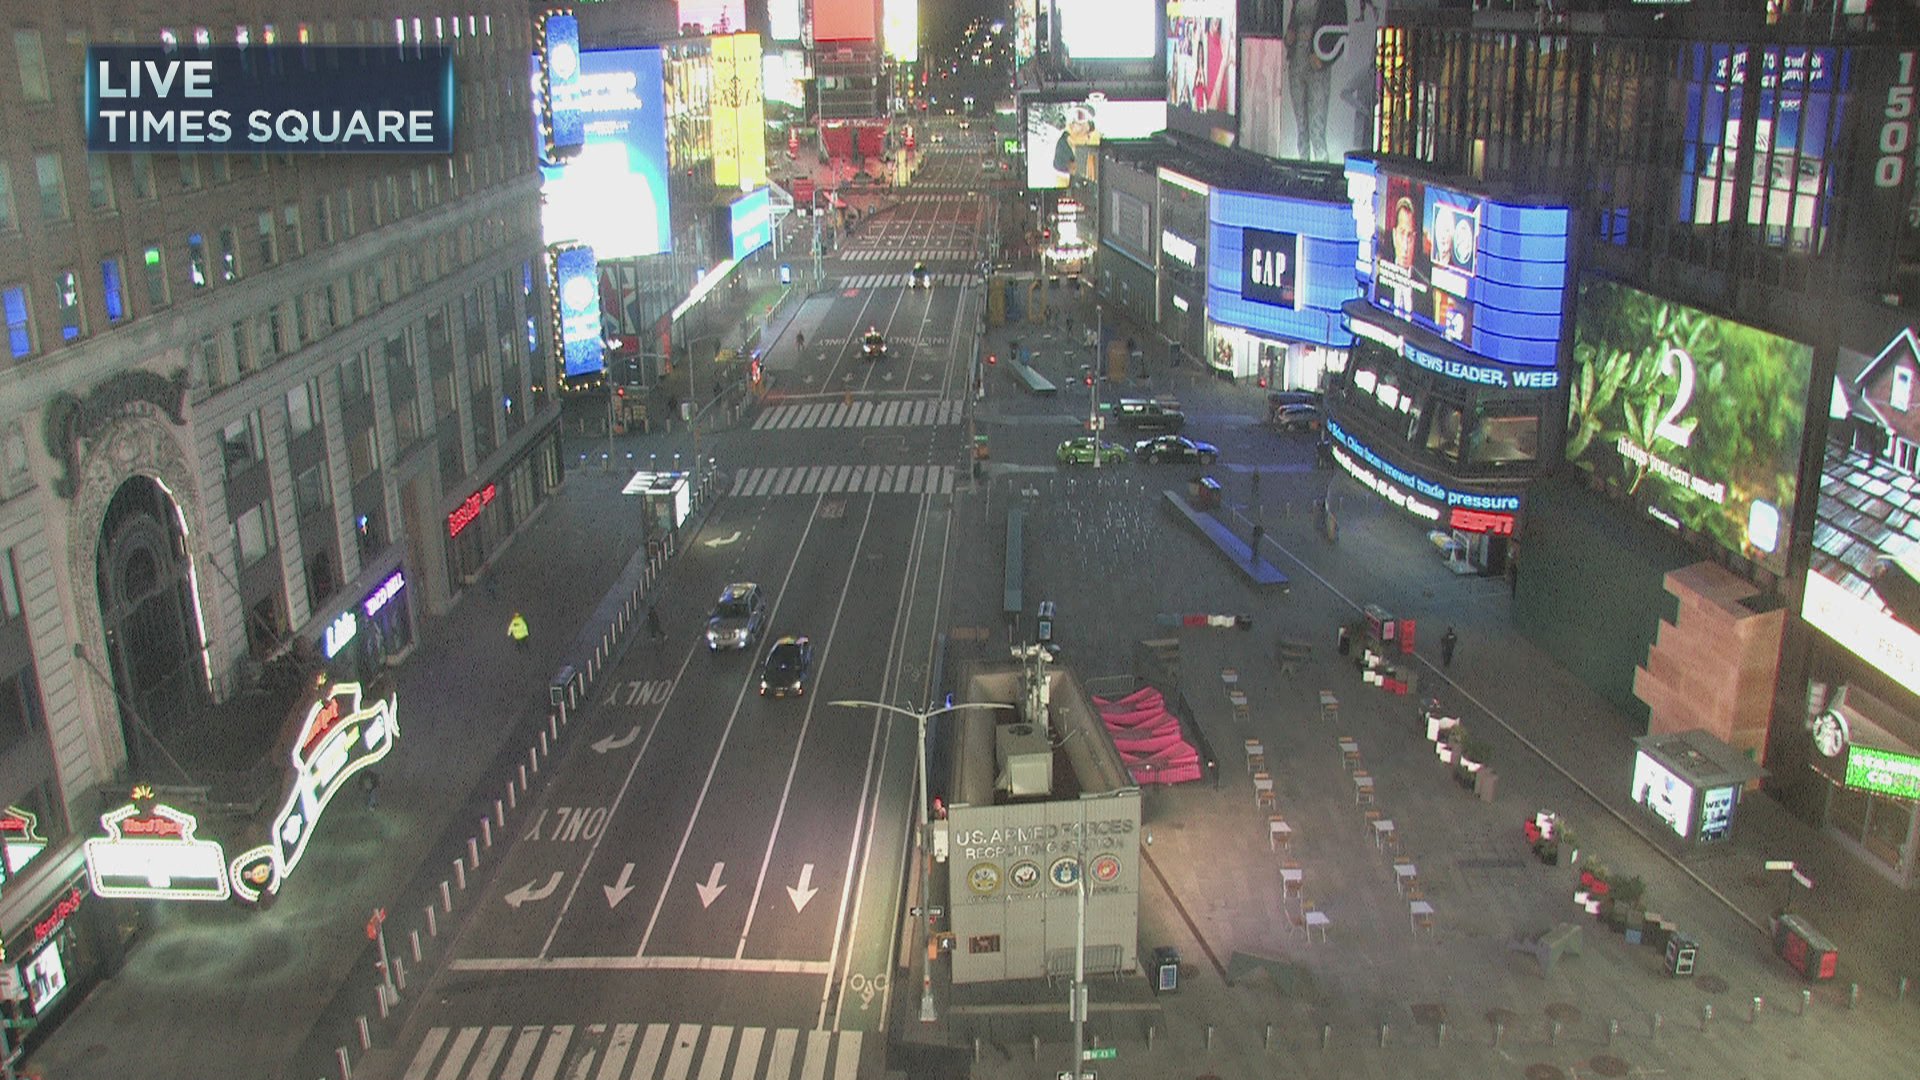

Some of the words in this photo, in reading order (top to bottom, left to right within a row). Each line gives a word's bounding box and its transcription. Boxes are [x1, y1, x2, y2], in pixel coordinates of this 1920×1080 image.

[1874, 52, 1914, 188] 1500
[1251, 248, 1287, 288] GAP
[1444, 360, 1508, 389] LEADER,
[1655, 348, 1693, 448] 2
[1416, 478, 1446, 501] trade
[1447, 491, 1519, 511] pressure
[604, 679, 673, 706] ONLY
[524, 806, 608, 842] ONLY
